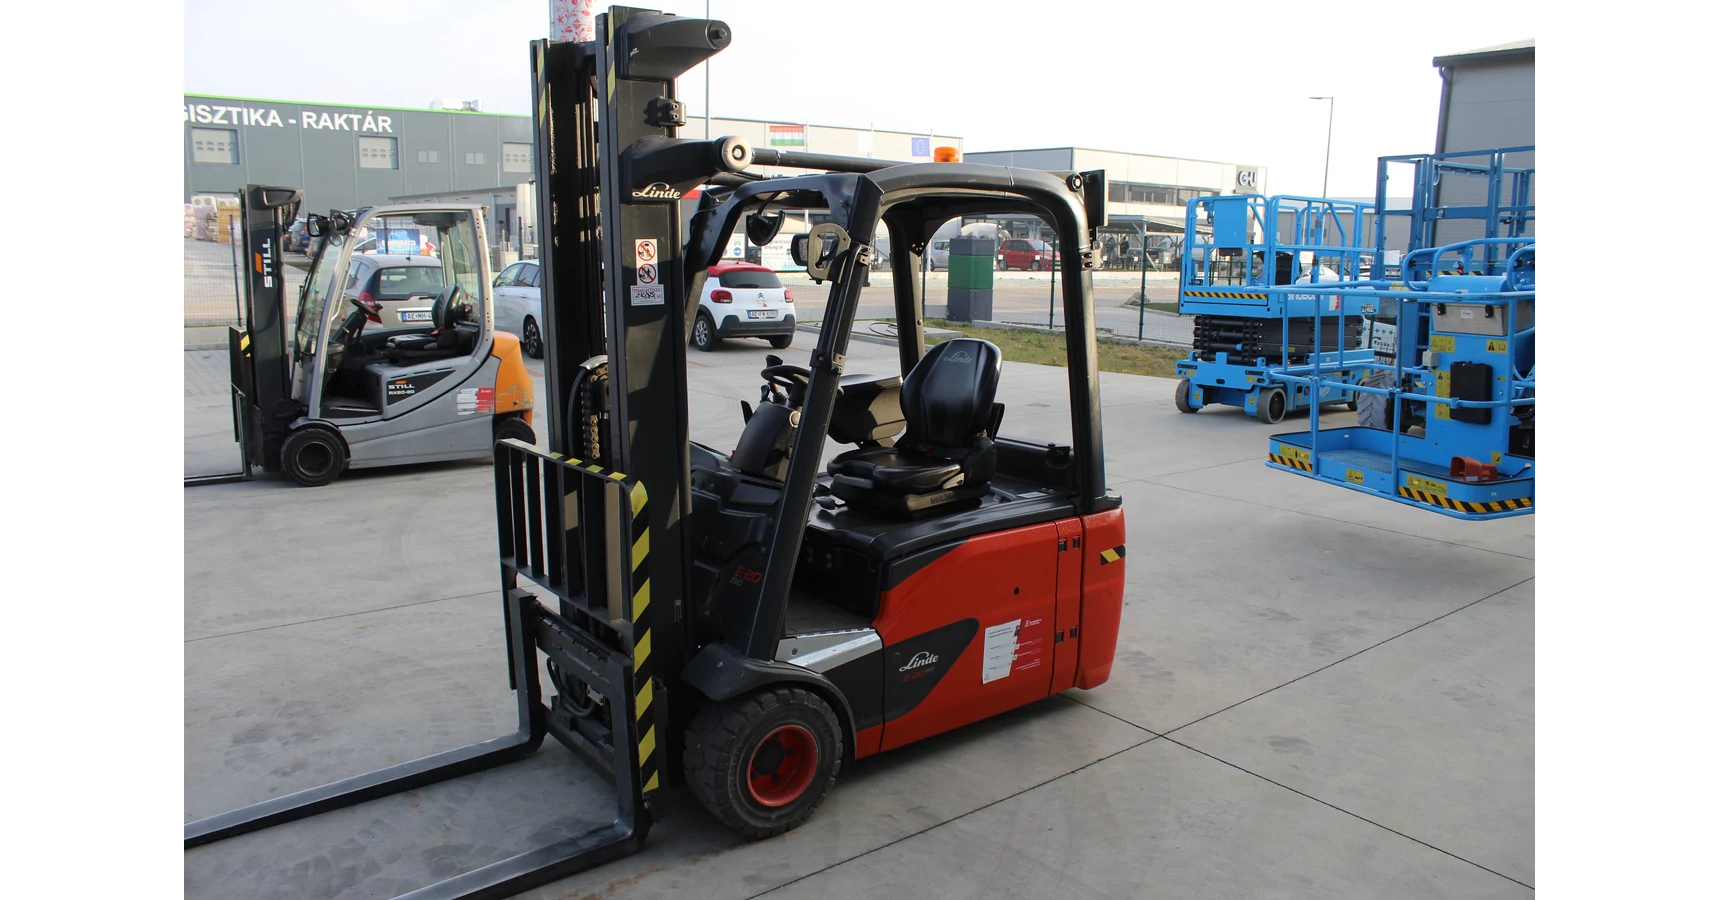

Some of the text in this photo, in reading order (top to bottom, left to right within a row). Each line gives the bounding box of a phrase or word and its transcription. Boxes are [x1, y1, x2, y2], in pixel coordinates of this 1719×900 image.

[302, 110, 393, 133] RAKTÁR
[632, 181, 681, 199] Linde
[262, 238, 273, 288] STILL
[943, 350, 973, 365] Linde
[898, 651, 939, 672] Linde
